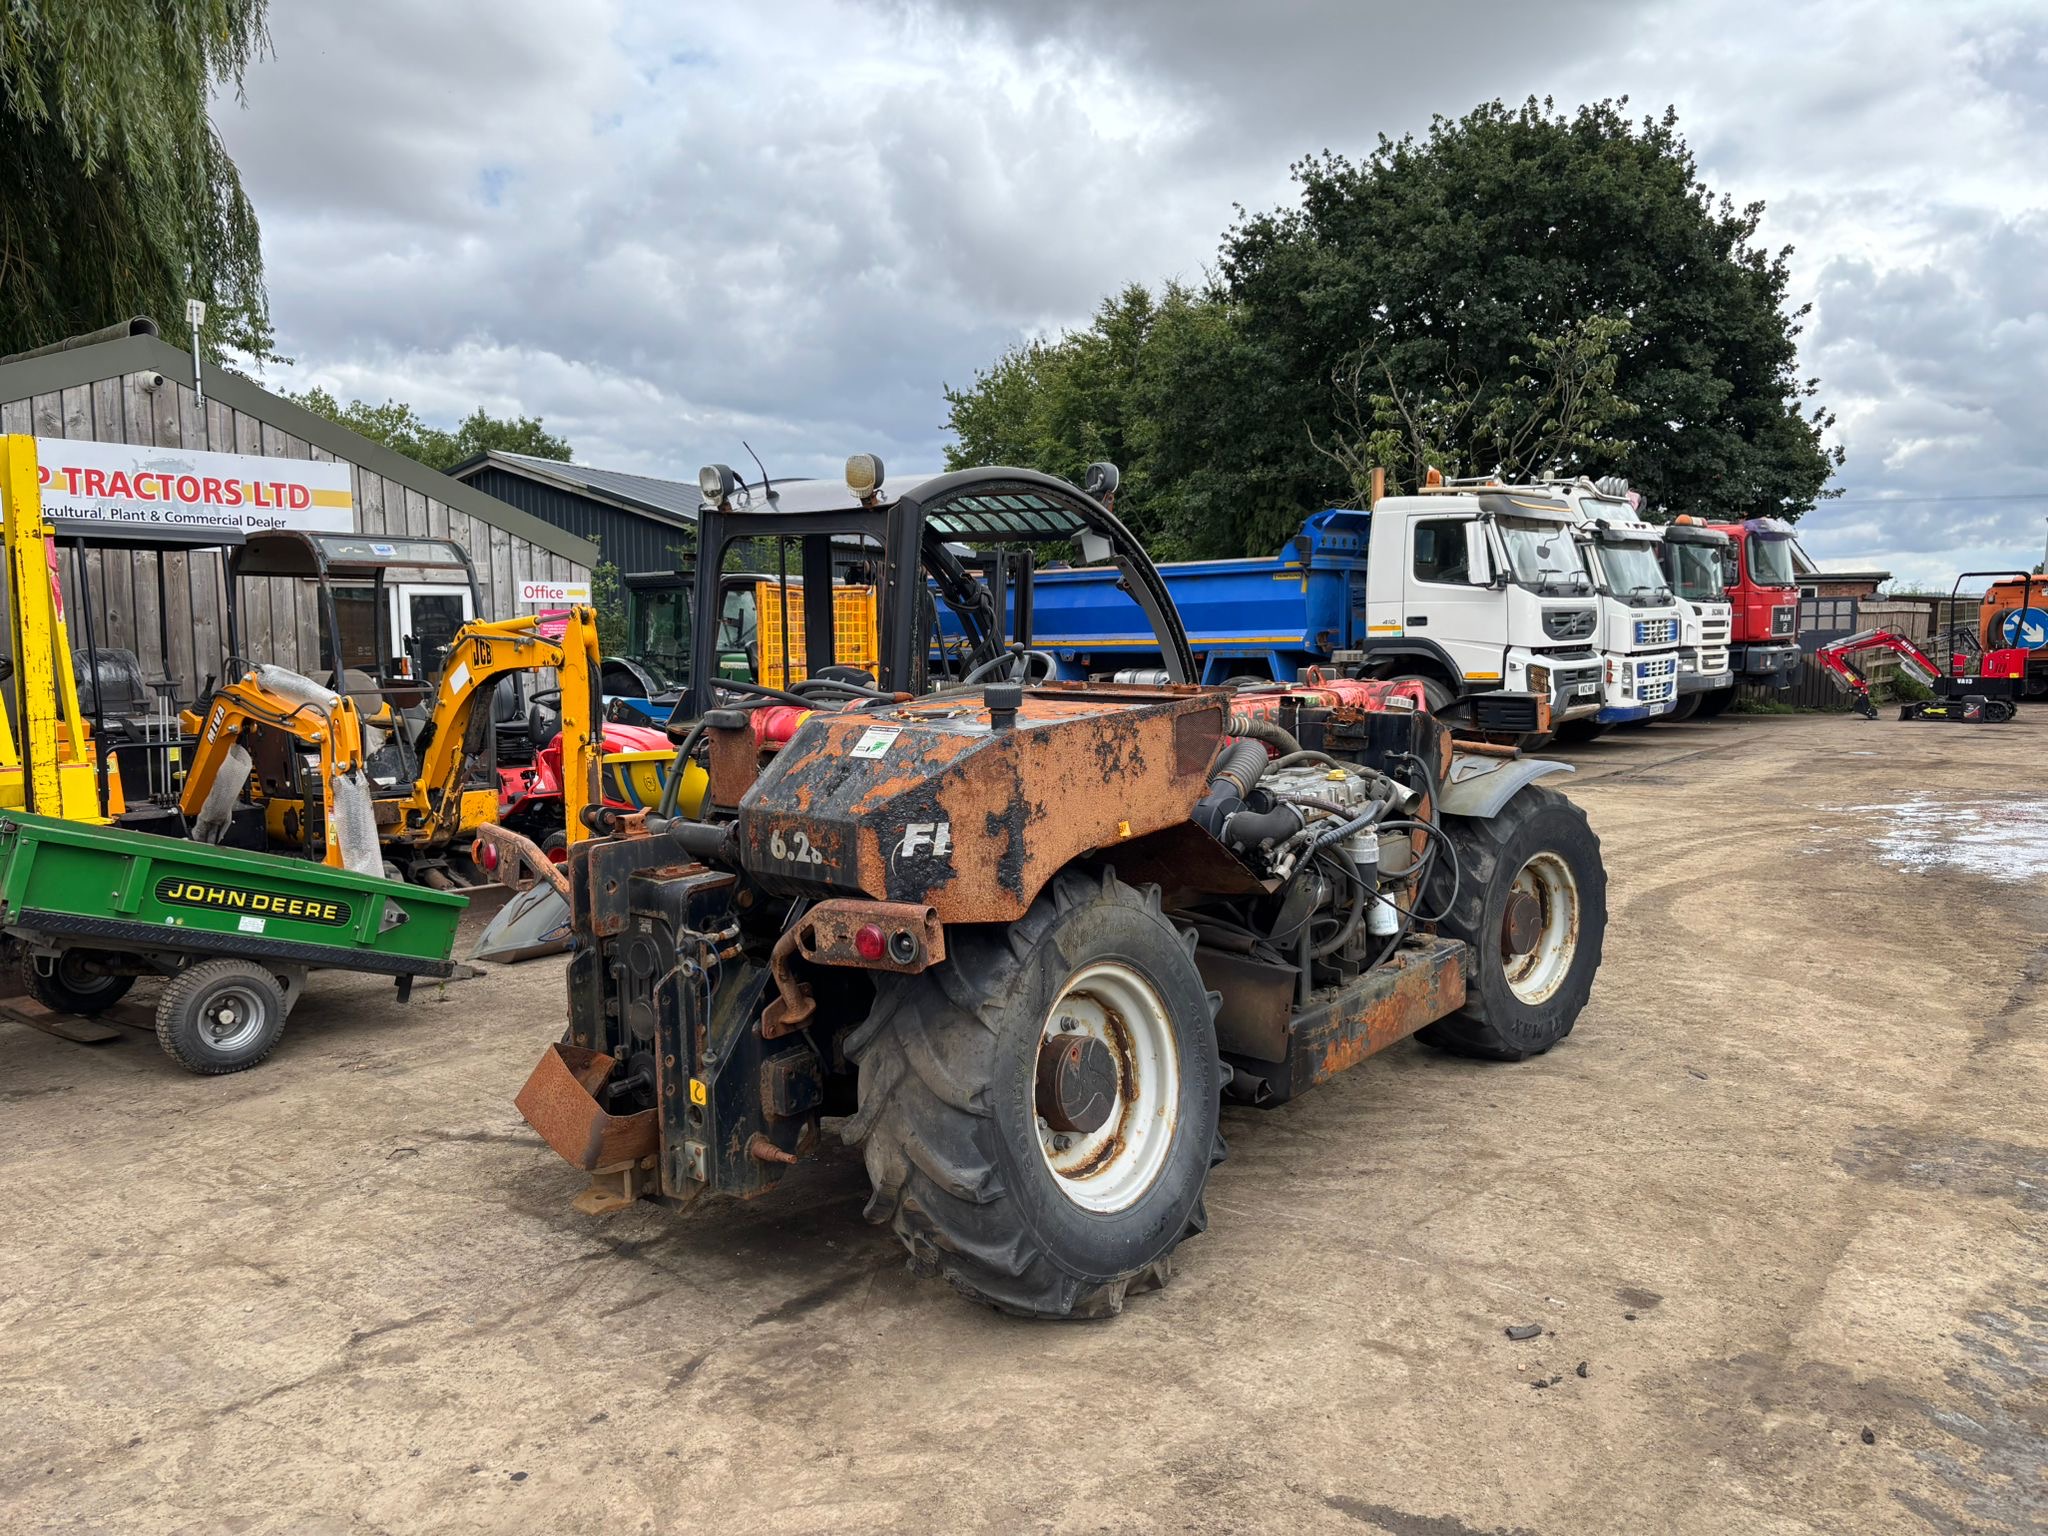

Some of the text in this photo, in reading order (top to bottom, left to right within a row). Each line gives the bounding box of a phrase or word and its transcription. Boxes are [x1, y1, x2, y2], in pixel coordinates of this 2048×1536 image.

[62, 467, 243, 506] TRACTORS
[254, 481, 311, 509] LTD
[41, 504, 287, 528] icultural, Plant & Commercial Dealer
[524, 585, 564, 599] Office
[473, 638, 492, 667] JCB
[207, 704, 225, 744] MIVA
[168, 883, 337, 920] JOHN DEERE
